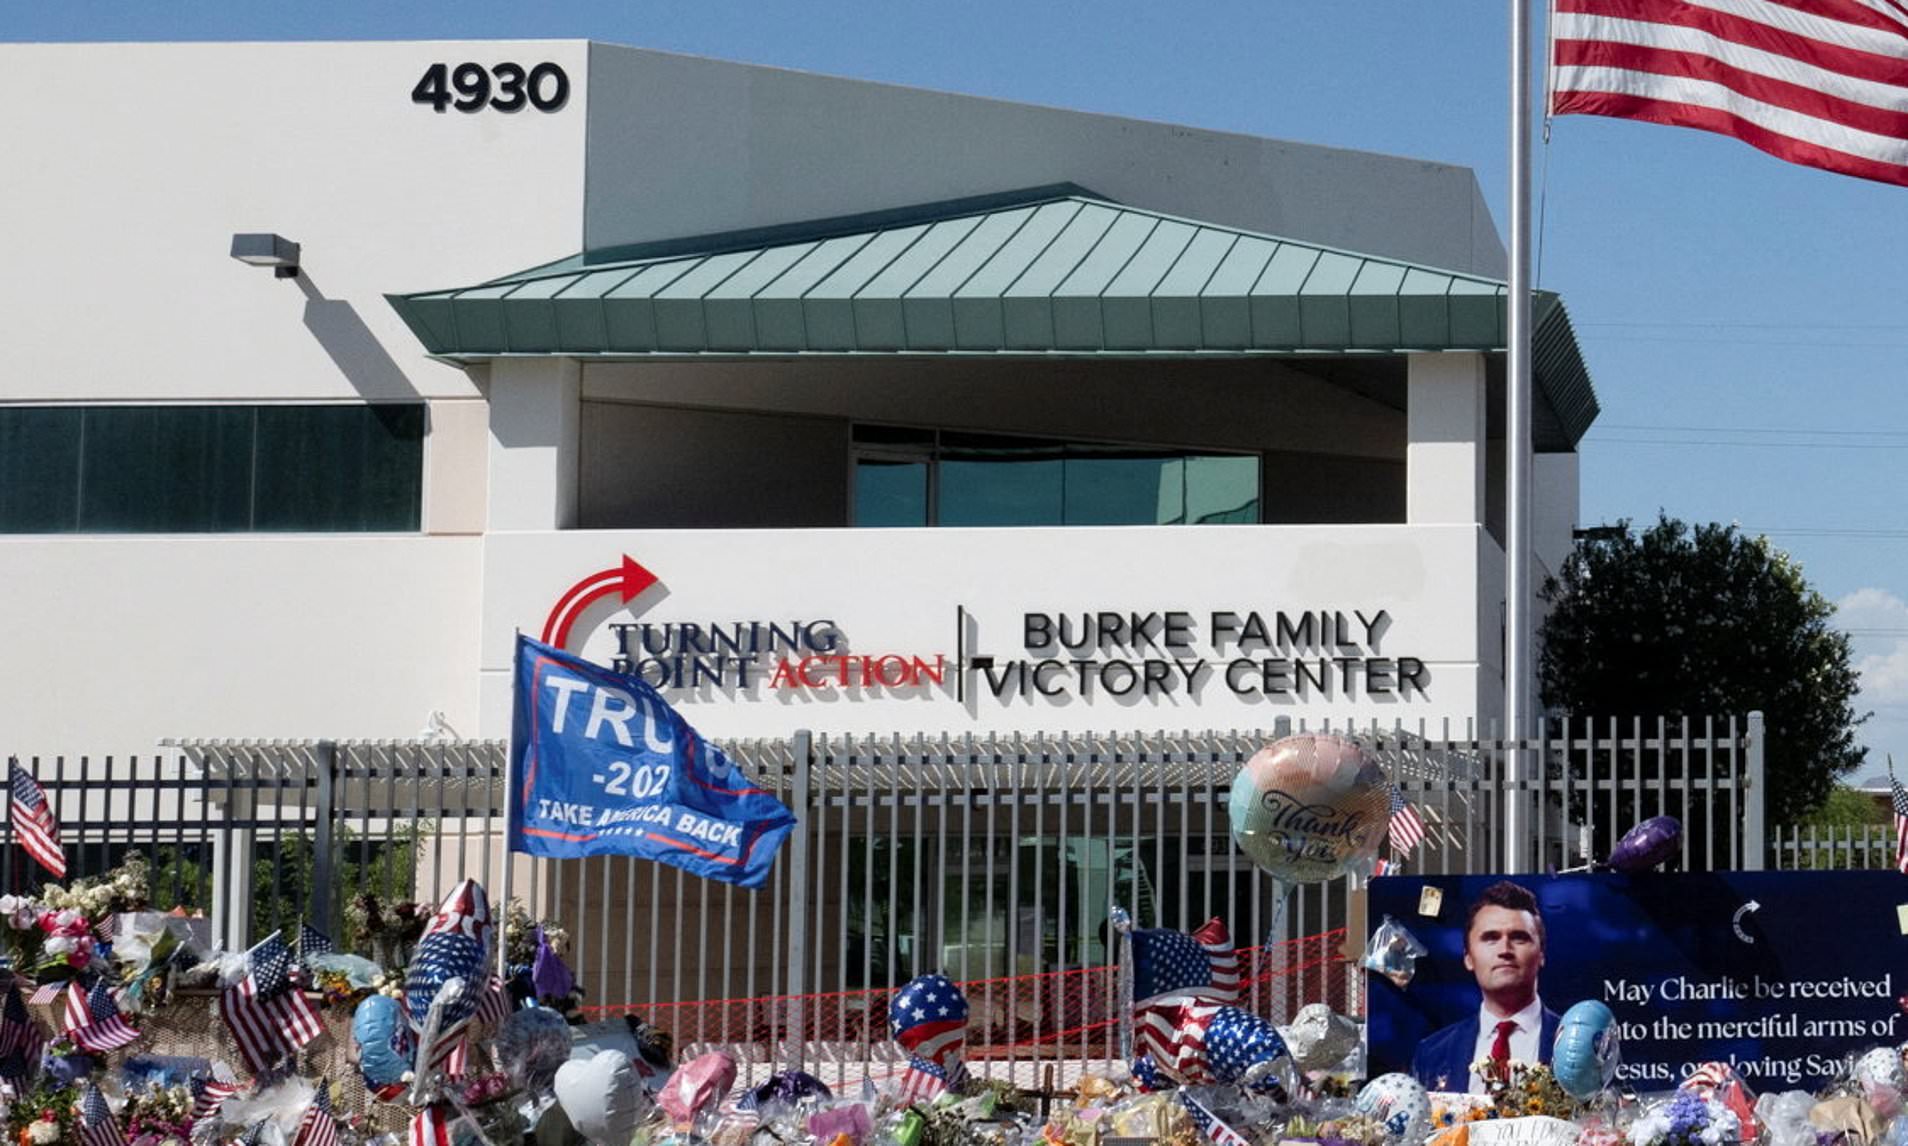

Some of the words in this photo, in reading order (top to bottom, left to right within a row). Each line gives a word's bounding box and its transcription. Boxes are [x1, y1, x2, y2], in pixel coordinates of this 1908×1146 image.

[412, 62, 569, 112] 4930
[608, 619, 837, 655] TURNING
[1023, 611, 1189, 650] BURKE
[1211, 609, 1386, 649] FAMILY
[612, 655, 759, 689] POINT
[768, 654, 945, 689] ACTION
[983, 657, 1205, 697] VICTORY
[1225, 657, 1427, 695] CENTER
[545, 675, 674, 754] TRU
[539, 800, 593, 827] TAKE
[596, 804, 673, 827] AMERICA
[676, 808, 744, 847] BACK
[1261, 789, 1366, 847] Thank
[1268, 829, 1338, 864] You
[1603, 978, 1654, 1006] May
[1660, 976, 1749, 1002] Charlie
[1754, 974, 1785, 999] be
[1790, 972, 1892, 998] received
[1653, 1015, 1693, 1040] the
[1697, 1013, 1798, 1039] merciful
[1803, 1019, 1866, 1038] arms
[1871, 1012, 1902, 1037] of
[1615, 1061, 1675, 1082] esus,
[1806, 1053, 1855, 1078] Savi
